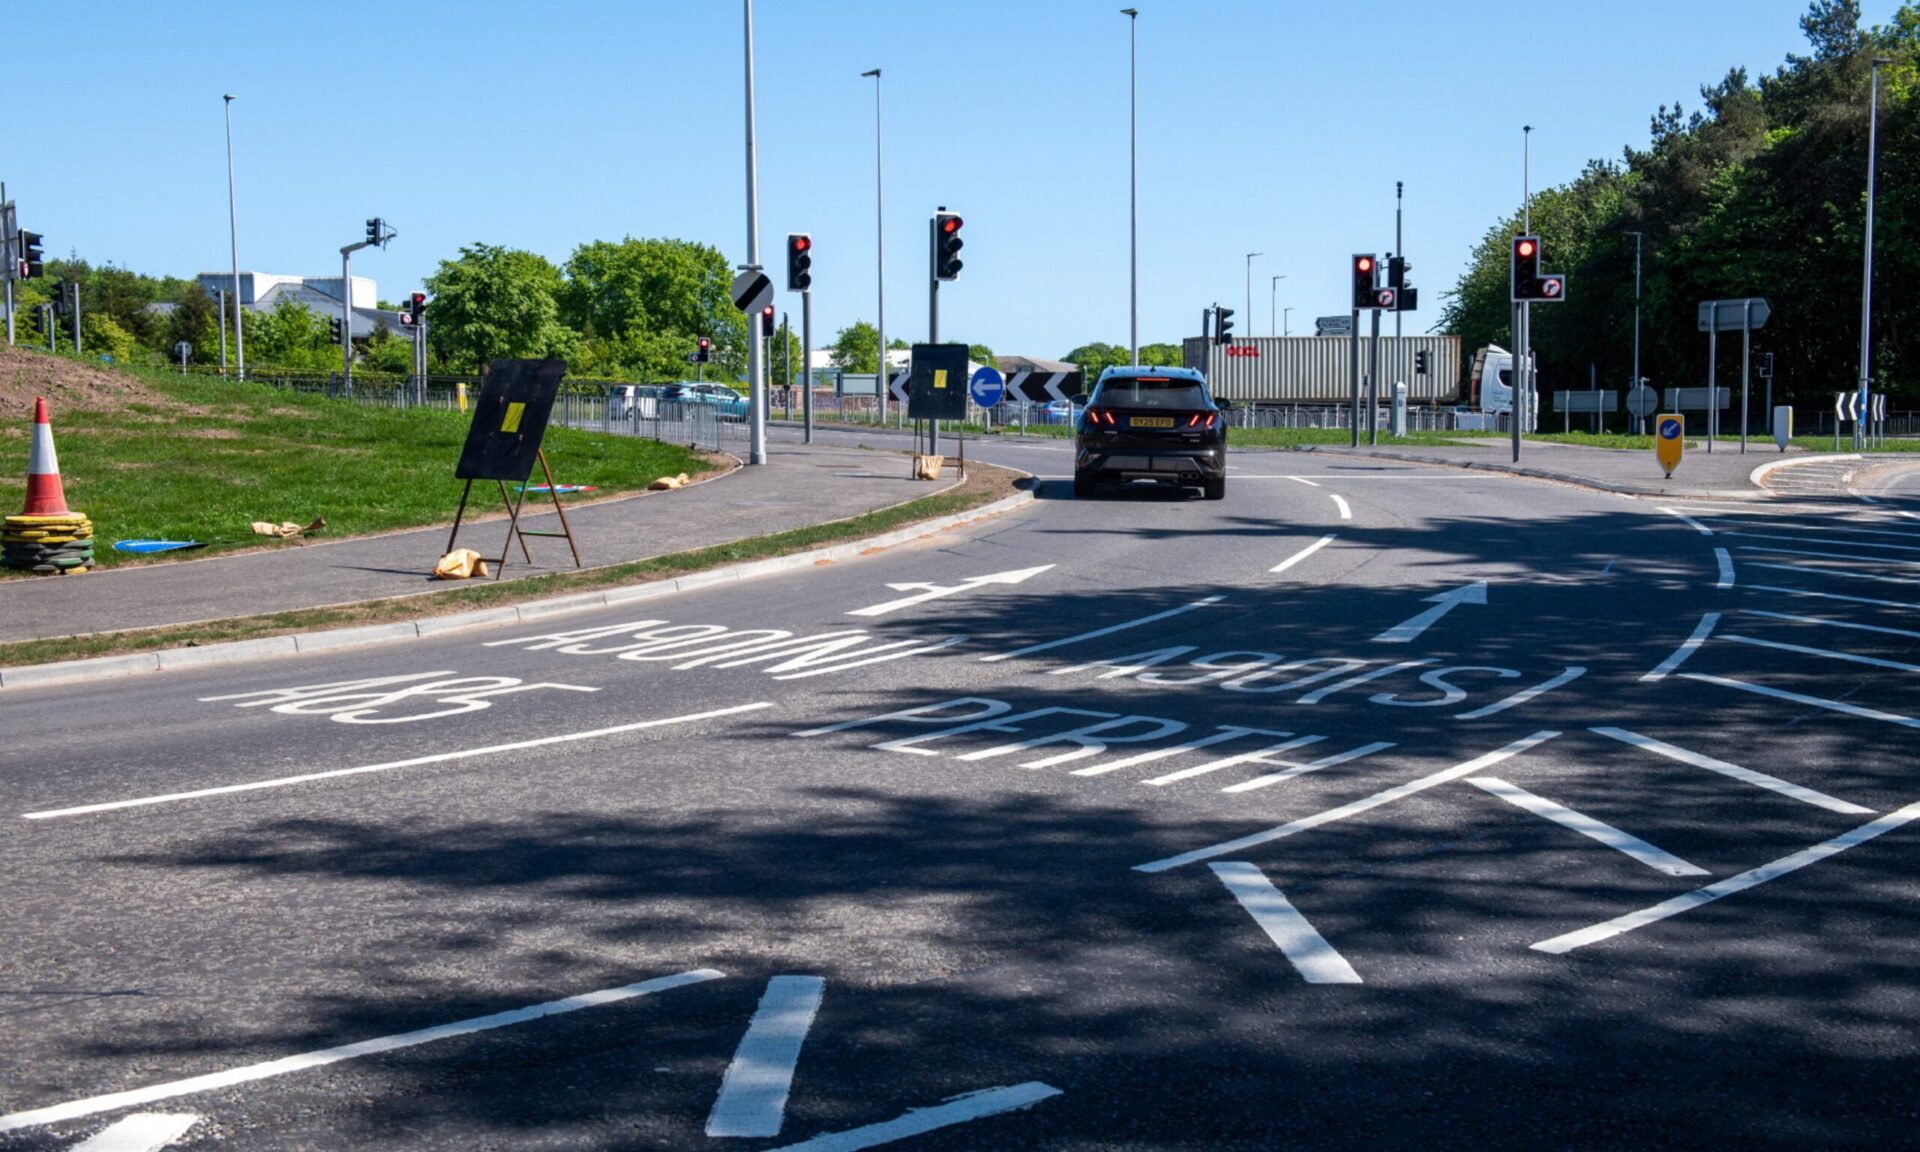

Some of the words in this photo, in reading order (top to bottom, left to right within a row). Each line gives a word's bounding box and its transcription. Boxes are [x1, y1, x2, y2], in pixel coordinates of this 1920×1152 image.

[482, 619, 969, 681] A90(N)
[1048, 645, 1587, 720] A90(S)
[198, 670, 602, 725] A85
[790, 697, 1399, 794] PERTH
